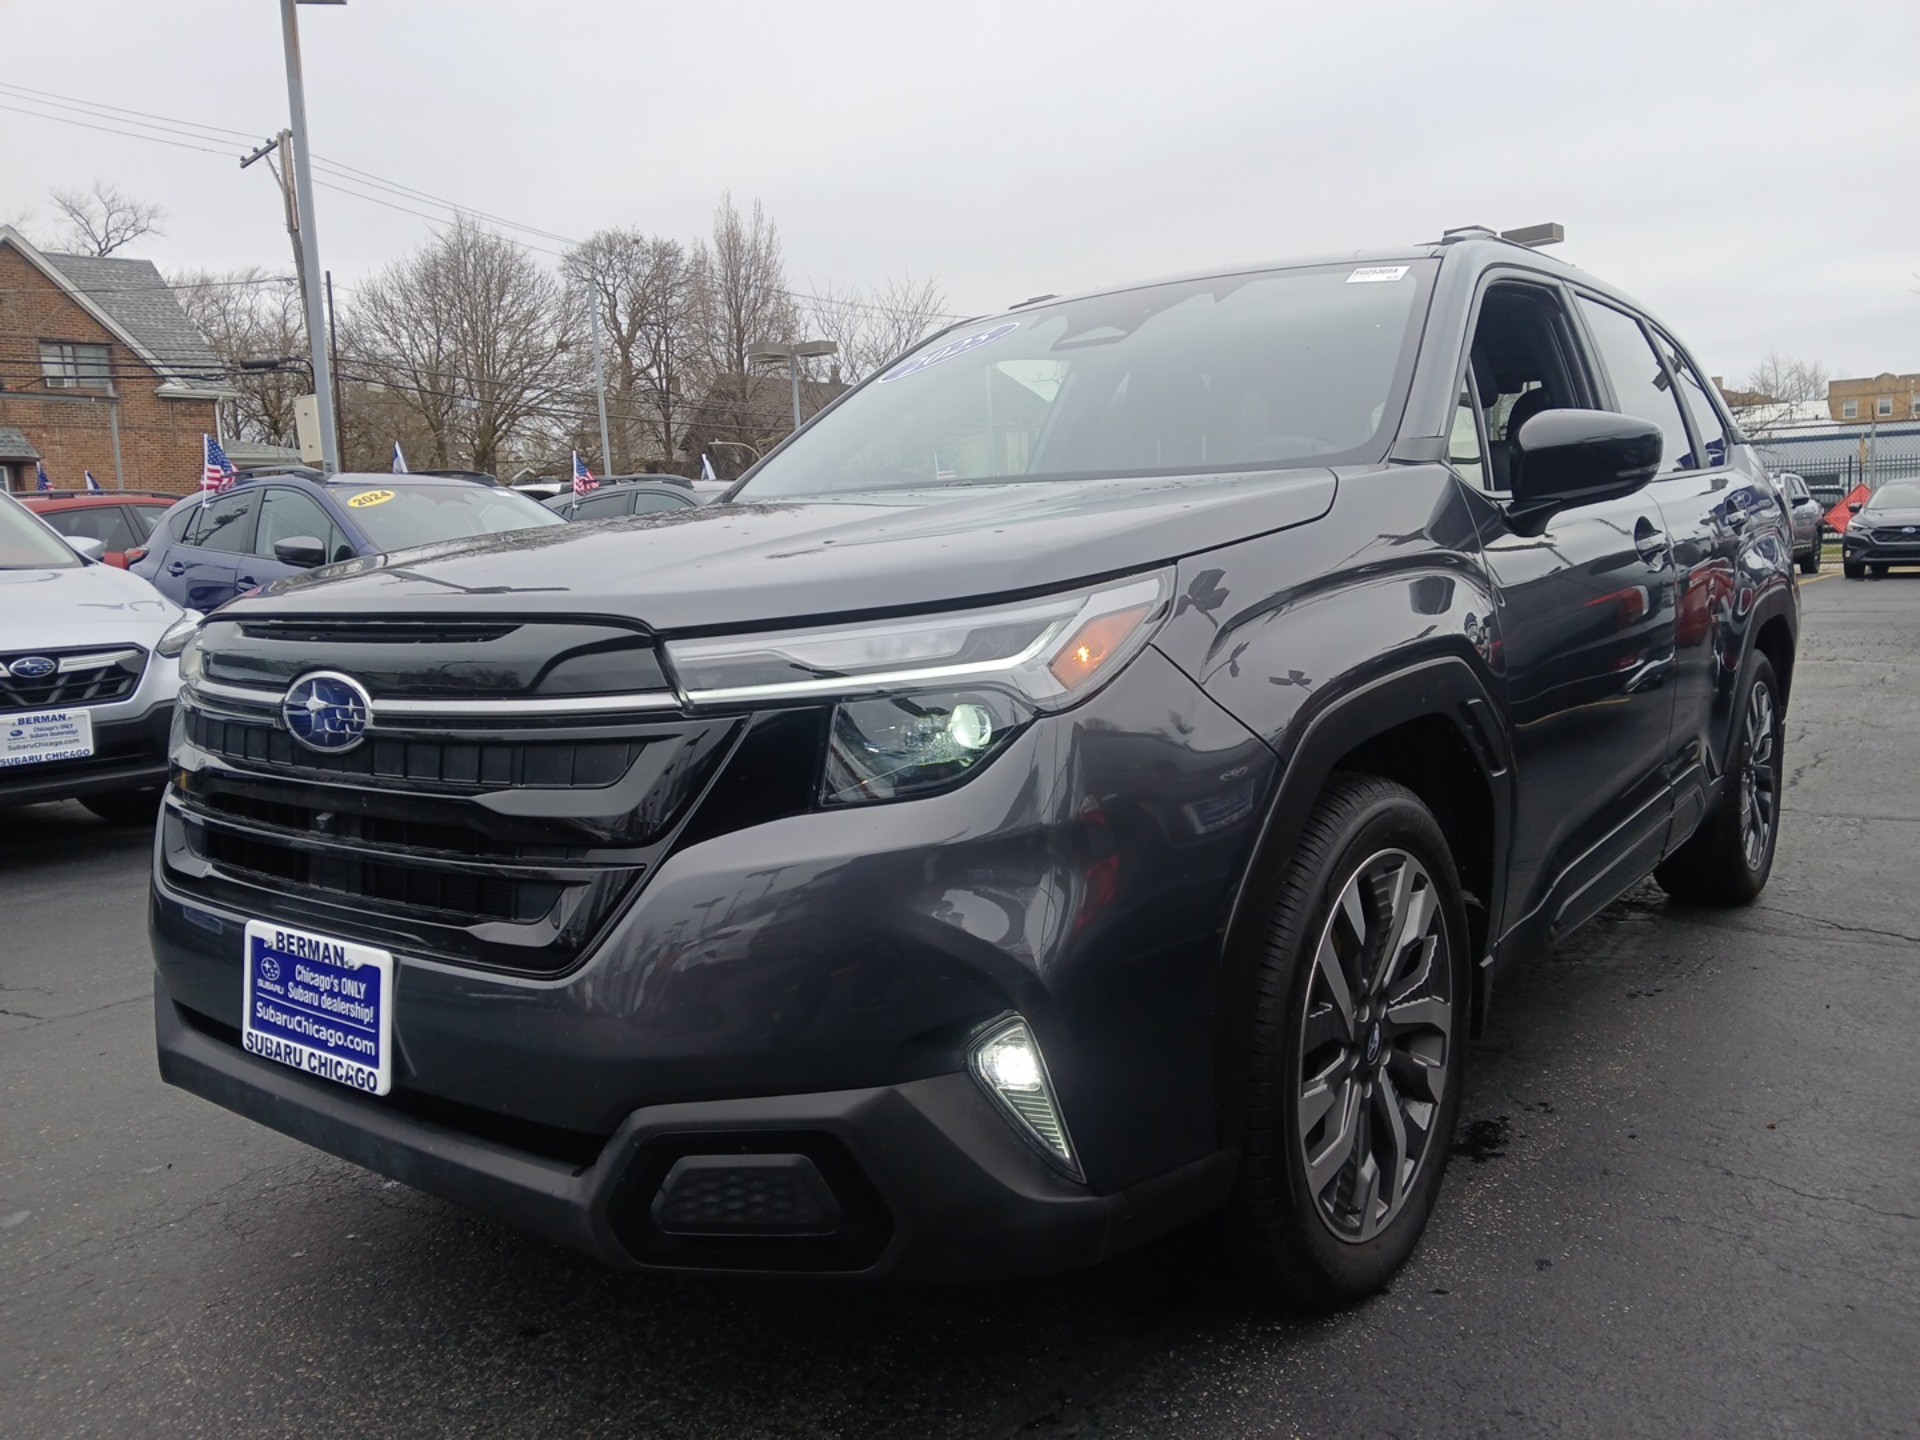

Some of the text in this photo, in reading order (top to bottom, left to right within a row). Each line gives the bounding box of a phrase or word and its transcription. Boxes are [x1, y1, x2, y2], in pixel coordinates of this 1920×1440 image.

[352, 491, 391, 506] 2024
[17, 713, 66, 726] BERMAN
[7, 738, 80, 751] SubaruChicago.com
[45, 748, 90, 761] CHICAGO
[275, 931, 345, 967] BERMAN
[257, 978, 284, 995] SUBARU
[295, 964, 366, 1000] Chicago's ONLY
[288, 982, 374, 1025] Subaru dealership!
[256, 1001, 375, 1056] SubaruChicago.com
[246, 1031, 378, 1093] SUBARU CHICAGO
